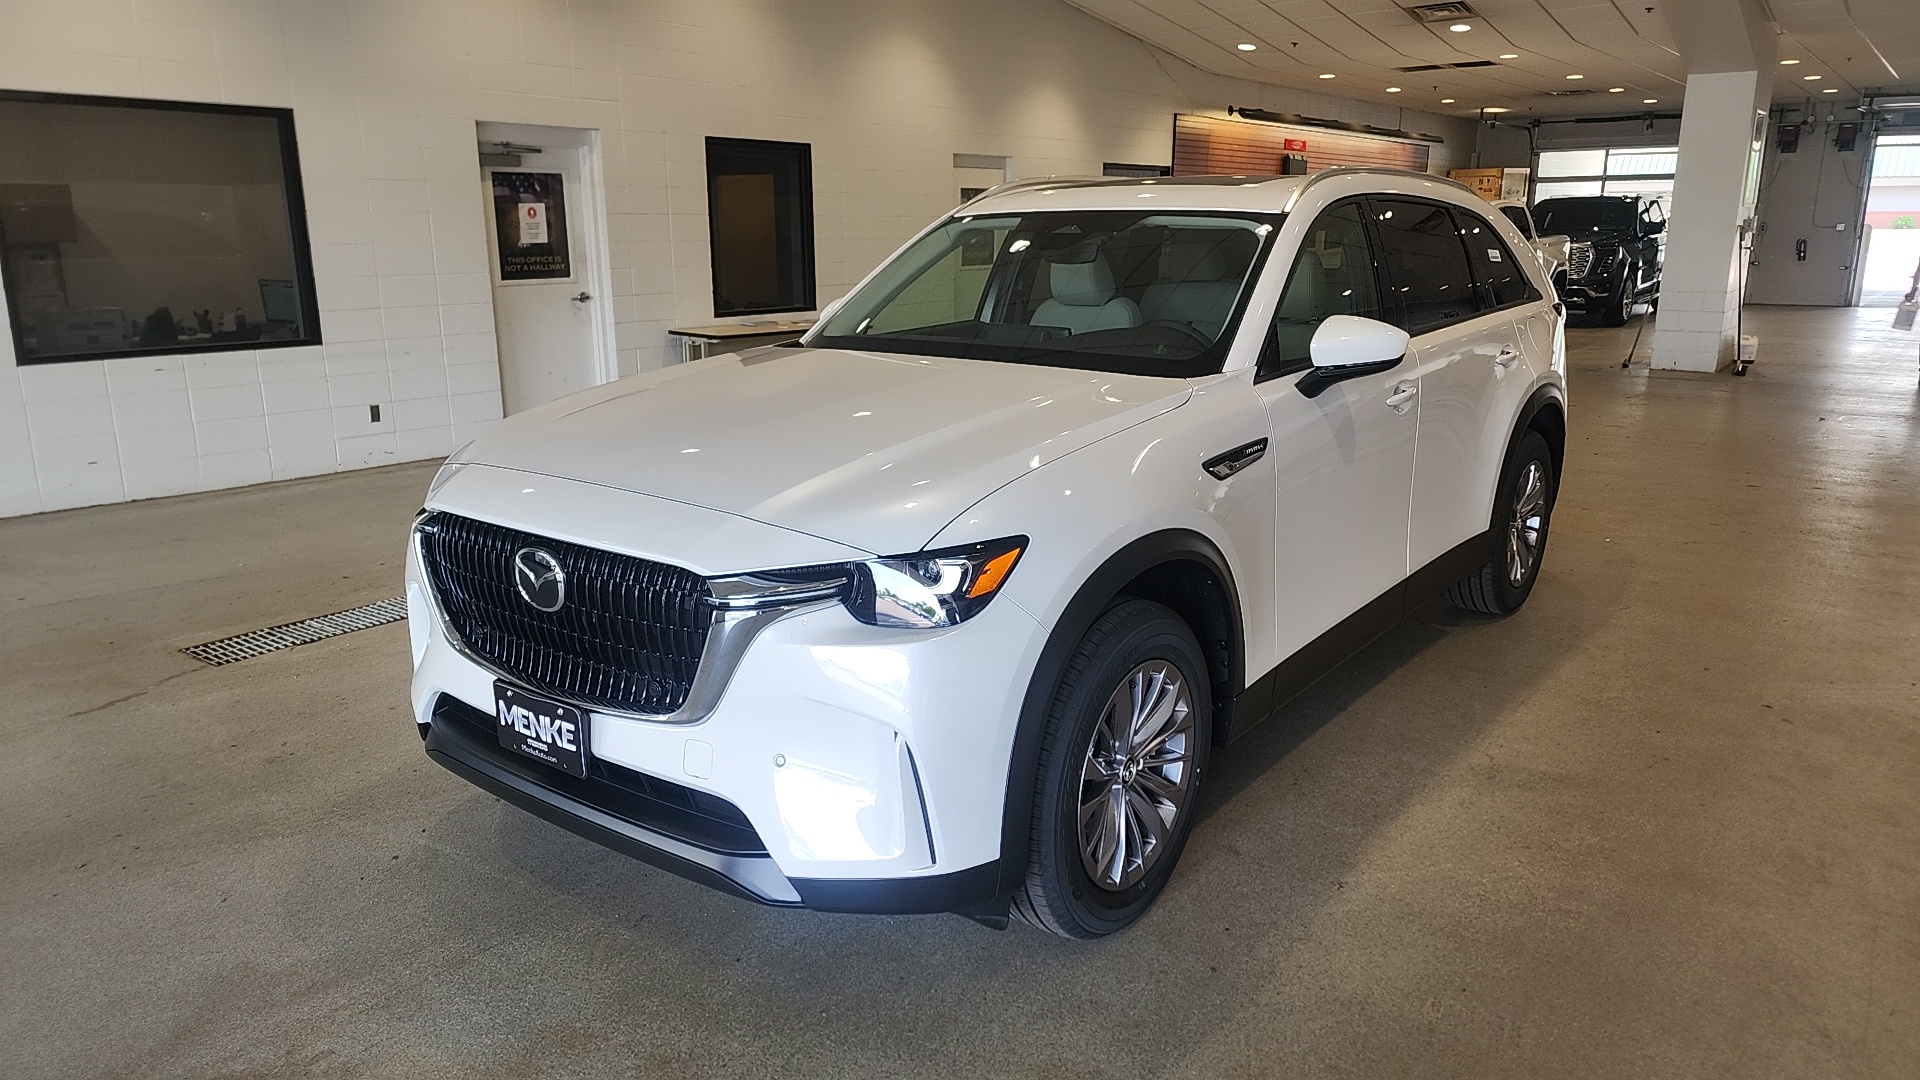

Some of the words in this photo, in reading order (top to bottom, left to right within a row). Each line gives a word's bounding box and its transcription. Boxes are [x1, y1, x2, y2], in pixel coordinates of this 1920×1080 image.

[526, 256, 554, 264] OFFICE
[504, 264, 521, 272] NOT
[530, 263, 565, 271] HALLWAY
[498, 699, 577, 752] MENKE
